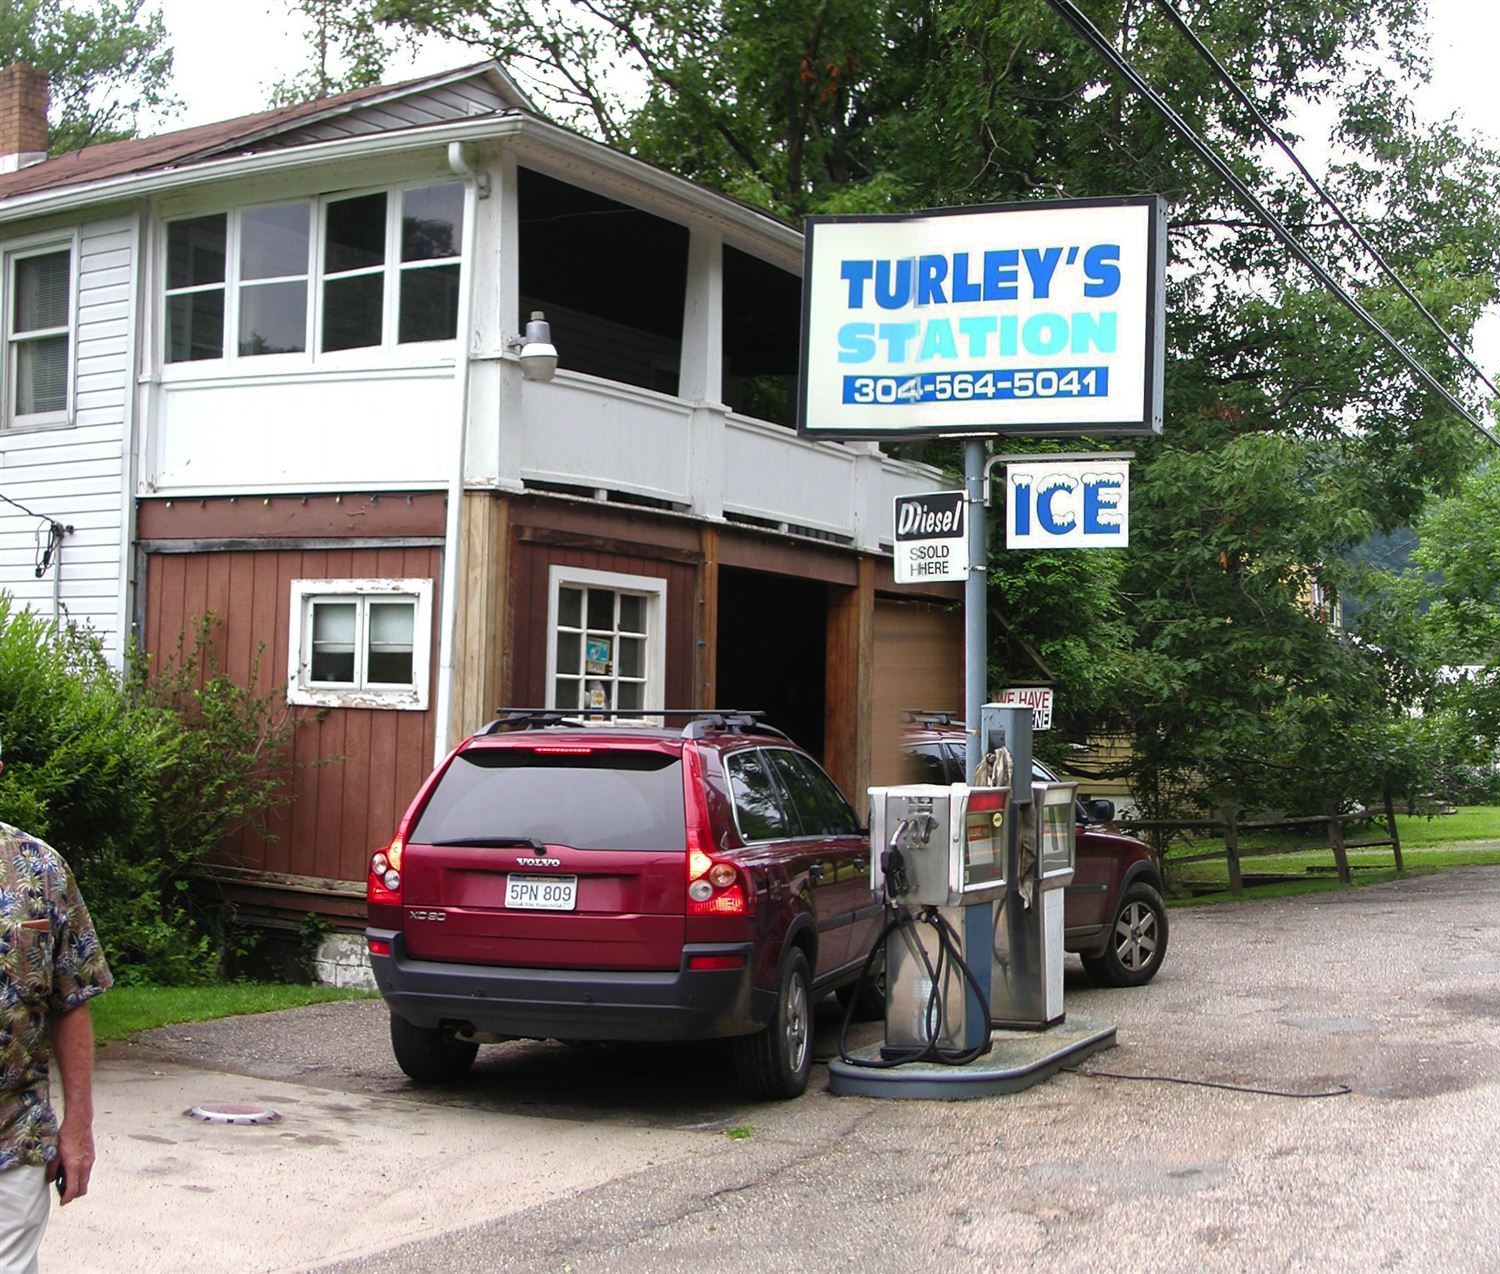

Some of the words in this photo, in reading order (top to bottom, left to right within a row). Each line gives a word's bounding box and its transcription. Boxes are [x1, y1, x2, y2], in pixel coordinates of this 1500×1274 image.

[840, 244, 1121, 310] TURLEY'S
[837, 312, 1118, 364] STATION
[853, 369, 1097, 403] 304-564-5041
[1011, 472, 1125, 536] ICE
[1019, 690, 1050, 709] HAVE
[515, 857, 561, 867] VOLVO
[510, 884, 539, 901] 5PN
[543, 885, 572, 902] 809
